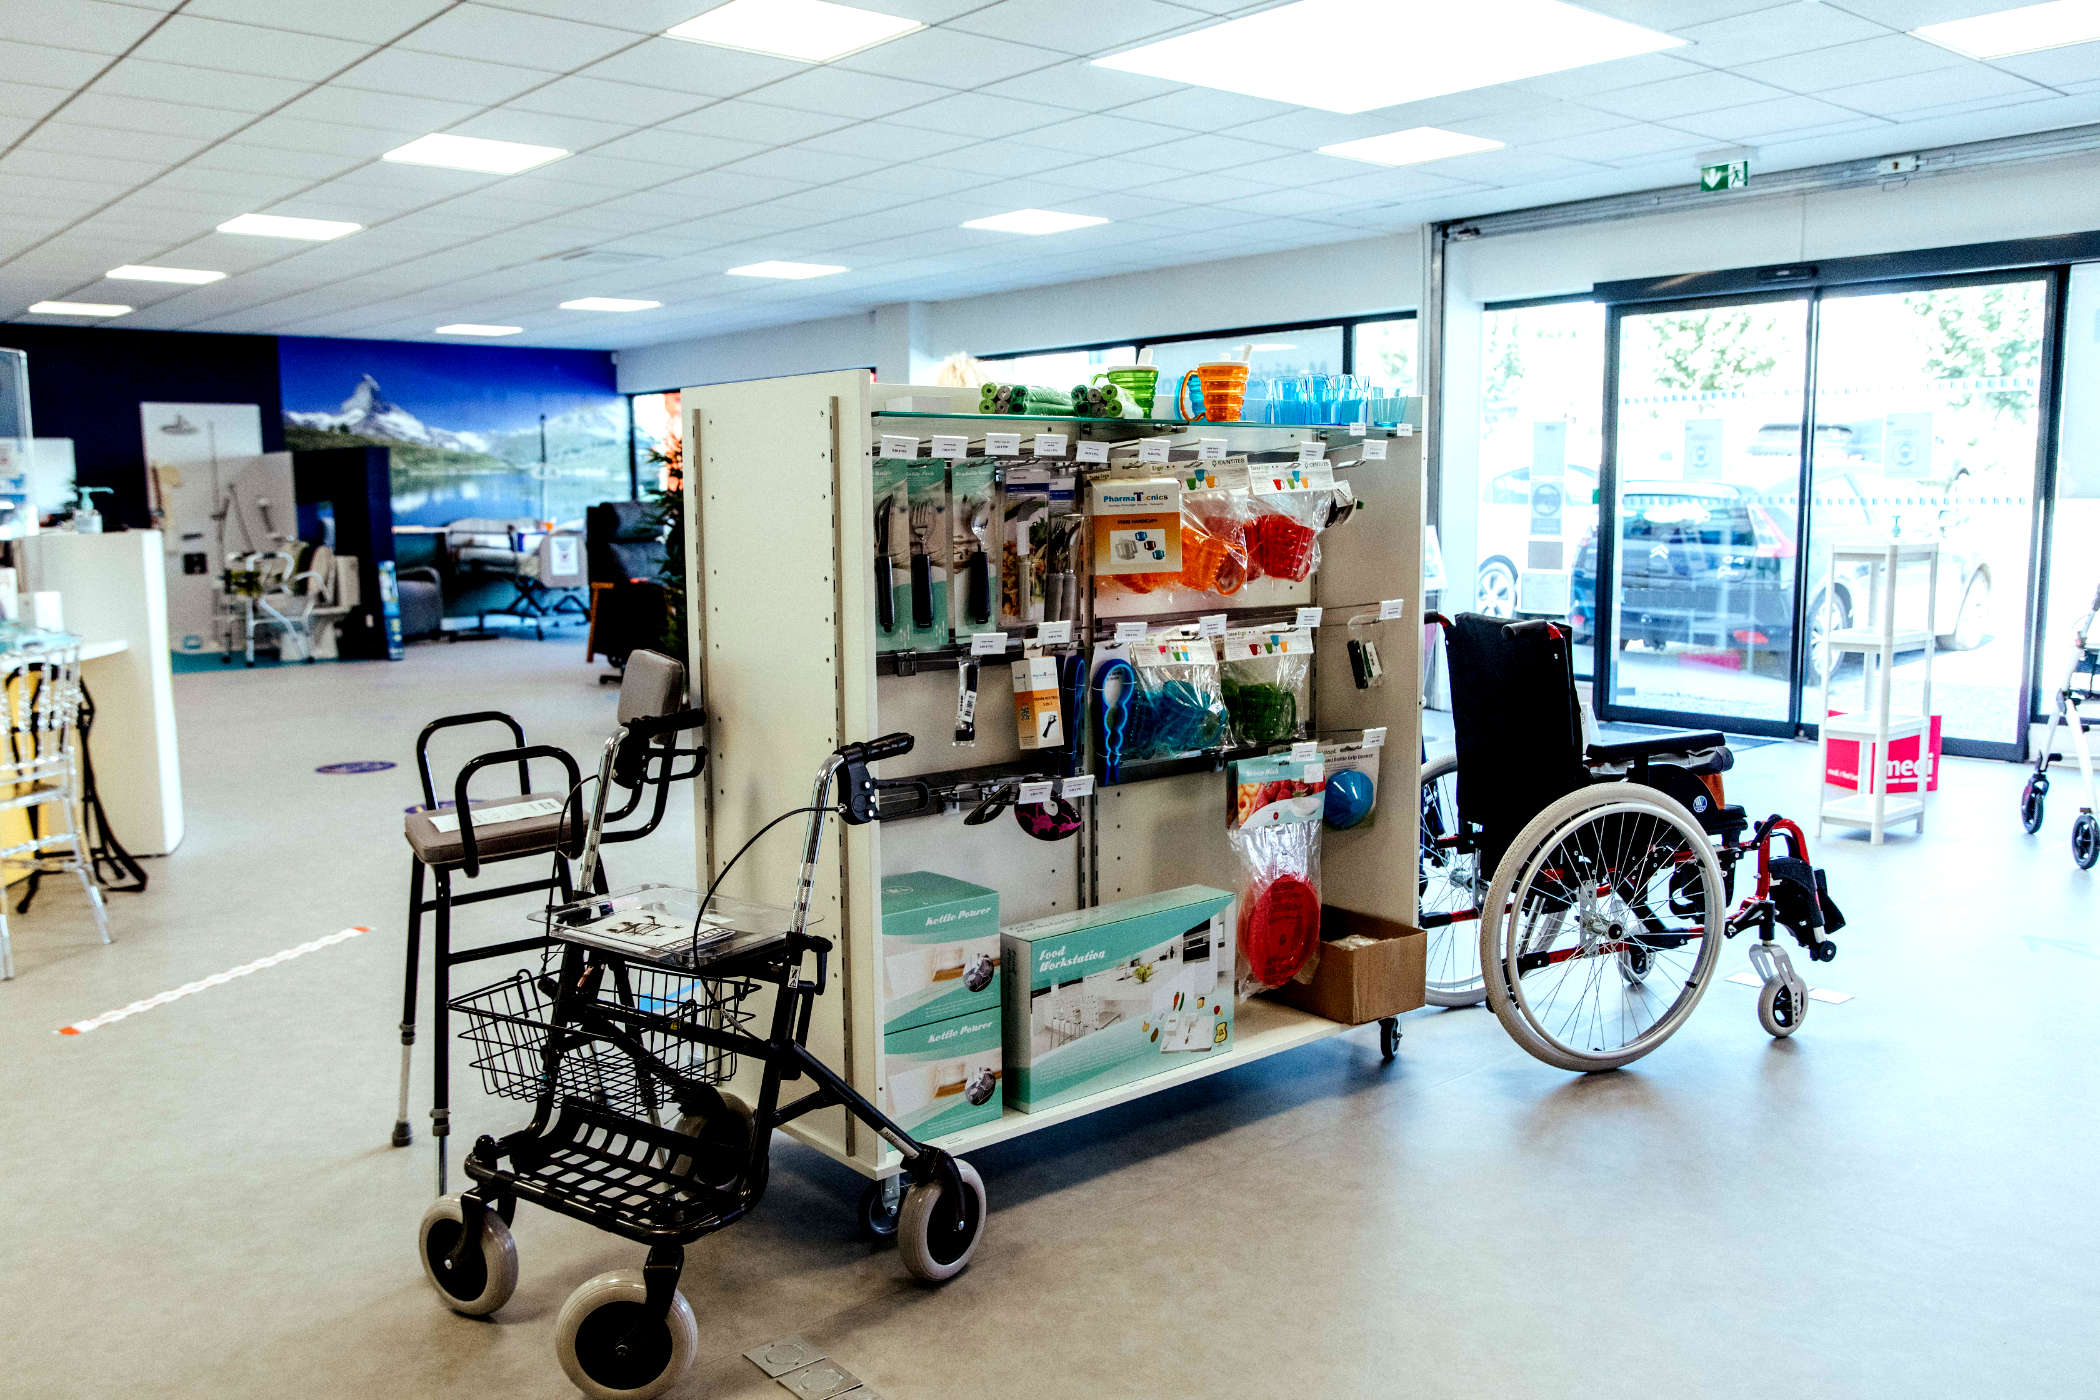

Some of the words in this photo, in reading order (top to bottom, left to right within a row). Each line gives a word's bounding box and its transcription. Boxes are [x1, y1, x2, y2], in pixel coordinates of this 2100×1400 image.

[958, 907, 992, 920] Pourer
[1039, 945, 1066, 961] Food
[1039, 950, 1106, 972] Workstation
[960, 1021, 993, 1035] Pourer
